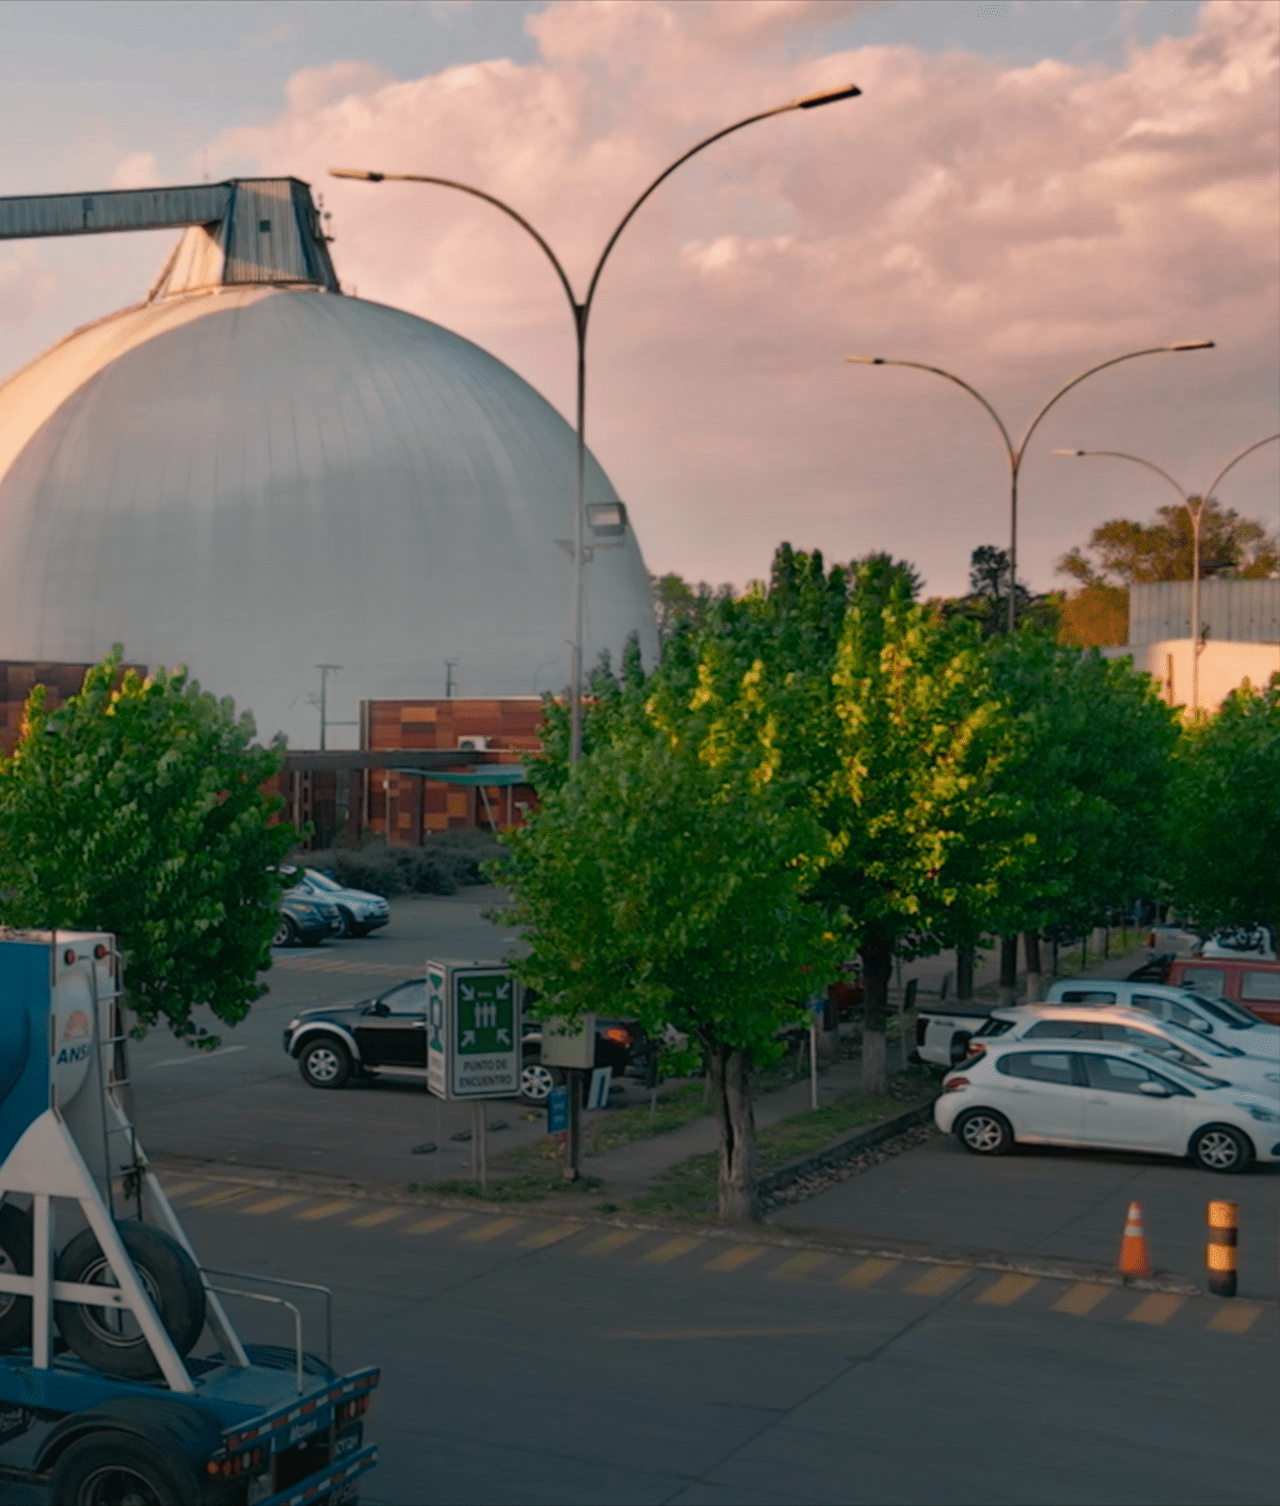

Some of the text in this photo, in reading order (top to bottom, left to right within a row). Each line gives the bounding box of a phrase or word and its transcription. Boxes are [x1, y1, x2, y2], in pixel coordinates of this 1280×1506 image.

[57, 1044, 89, 1065] ANS
[463, 1060, 493, 1072] PUNTO
[459, 1074, 512, 1088] ENCUENTRO
